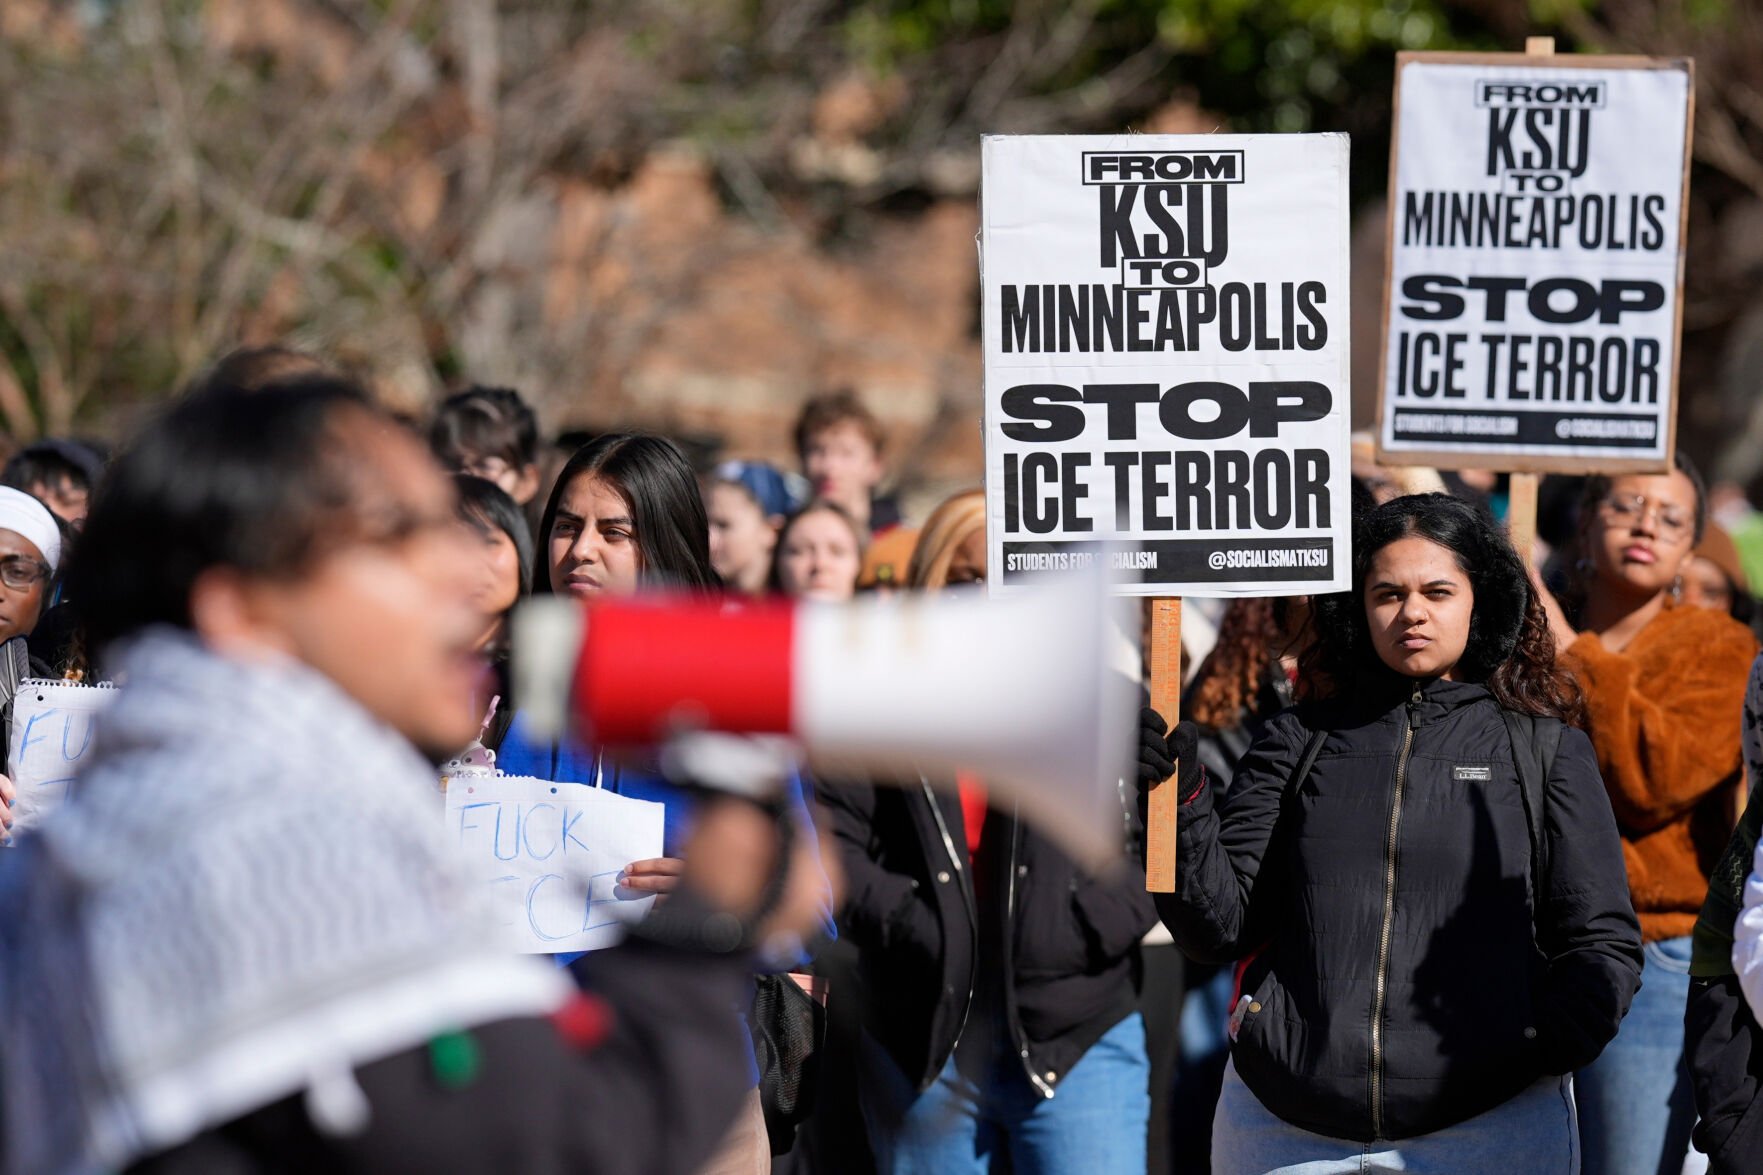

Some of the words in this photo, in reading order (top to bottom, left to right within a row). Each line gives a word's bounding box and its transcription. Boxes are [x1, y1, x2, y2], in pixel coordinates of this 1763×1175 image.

[1483, 85, 1598, 104] FROM
[1090, 154, 1237, 180] FROM
[1486, 107, 1590, 177] KSU
[1509, 174, 1563, 193] TO
[1100, 184, 1229, 268] KSU
[1403, 191, 1664, 252] MINNEAPOLIS
[1129, 260, 1200, 286] TO
[1400, 275, 1665, 324] STOP
[1001, 280, 1328, 353] MINNEAPOLIS
[1397, 332, 1466, 399] ICE
[1481, 334, 1660, 404] TERROR
[1000, 380, 1333, 442] STOP
[1003, 452, 1093, 533] ICE
[1105, 448, 1332, 532] TERROR
[1007, 552, 1069, 571] STUDENTS
[1208, 549, 1328, 570] @SOCIALISMATKSU
[19, 707, 96, 766] FU
[456, 802, 590, 861] FUCK
